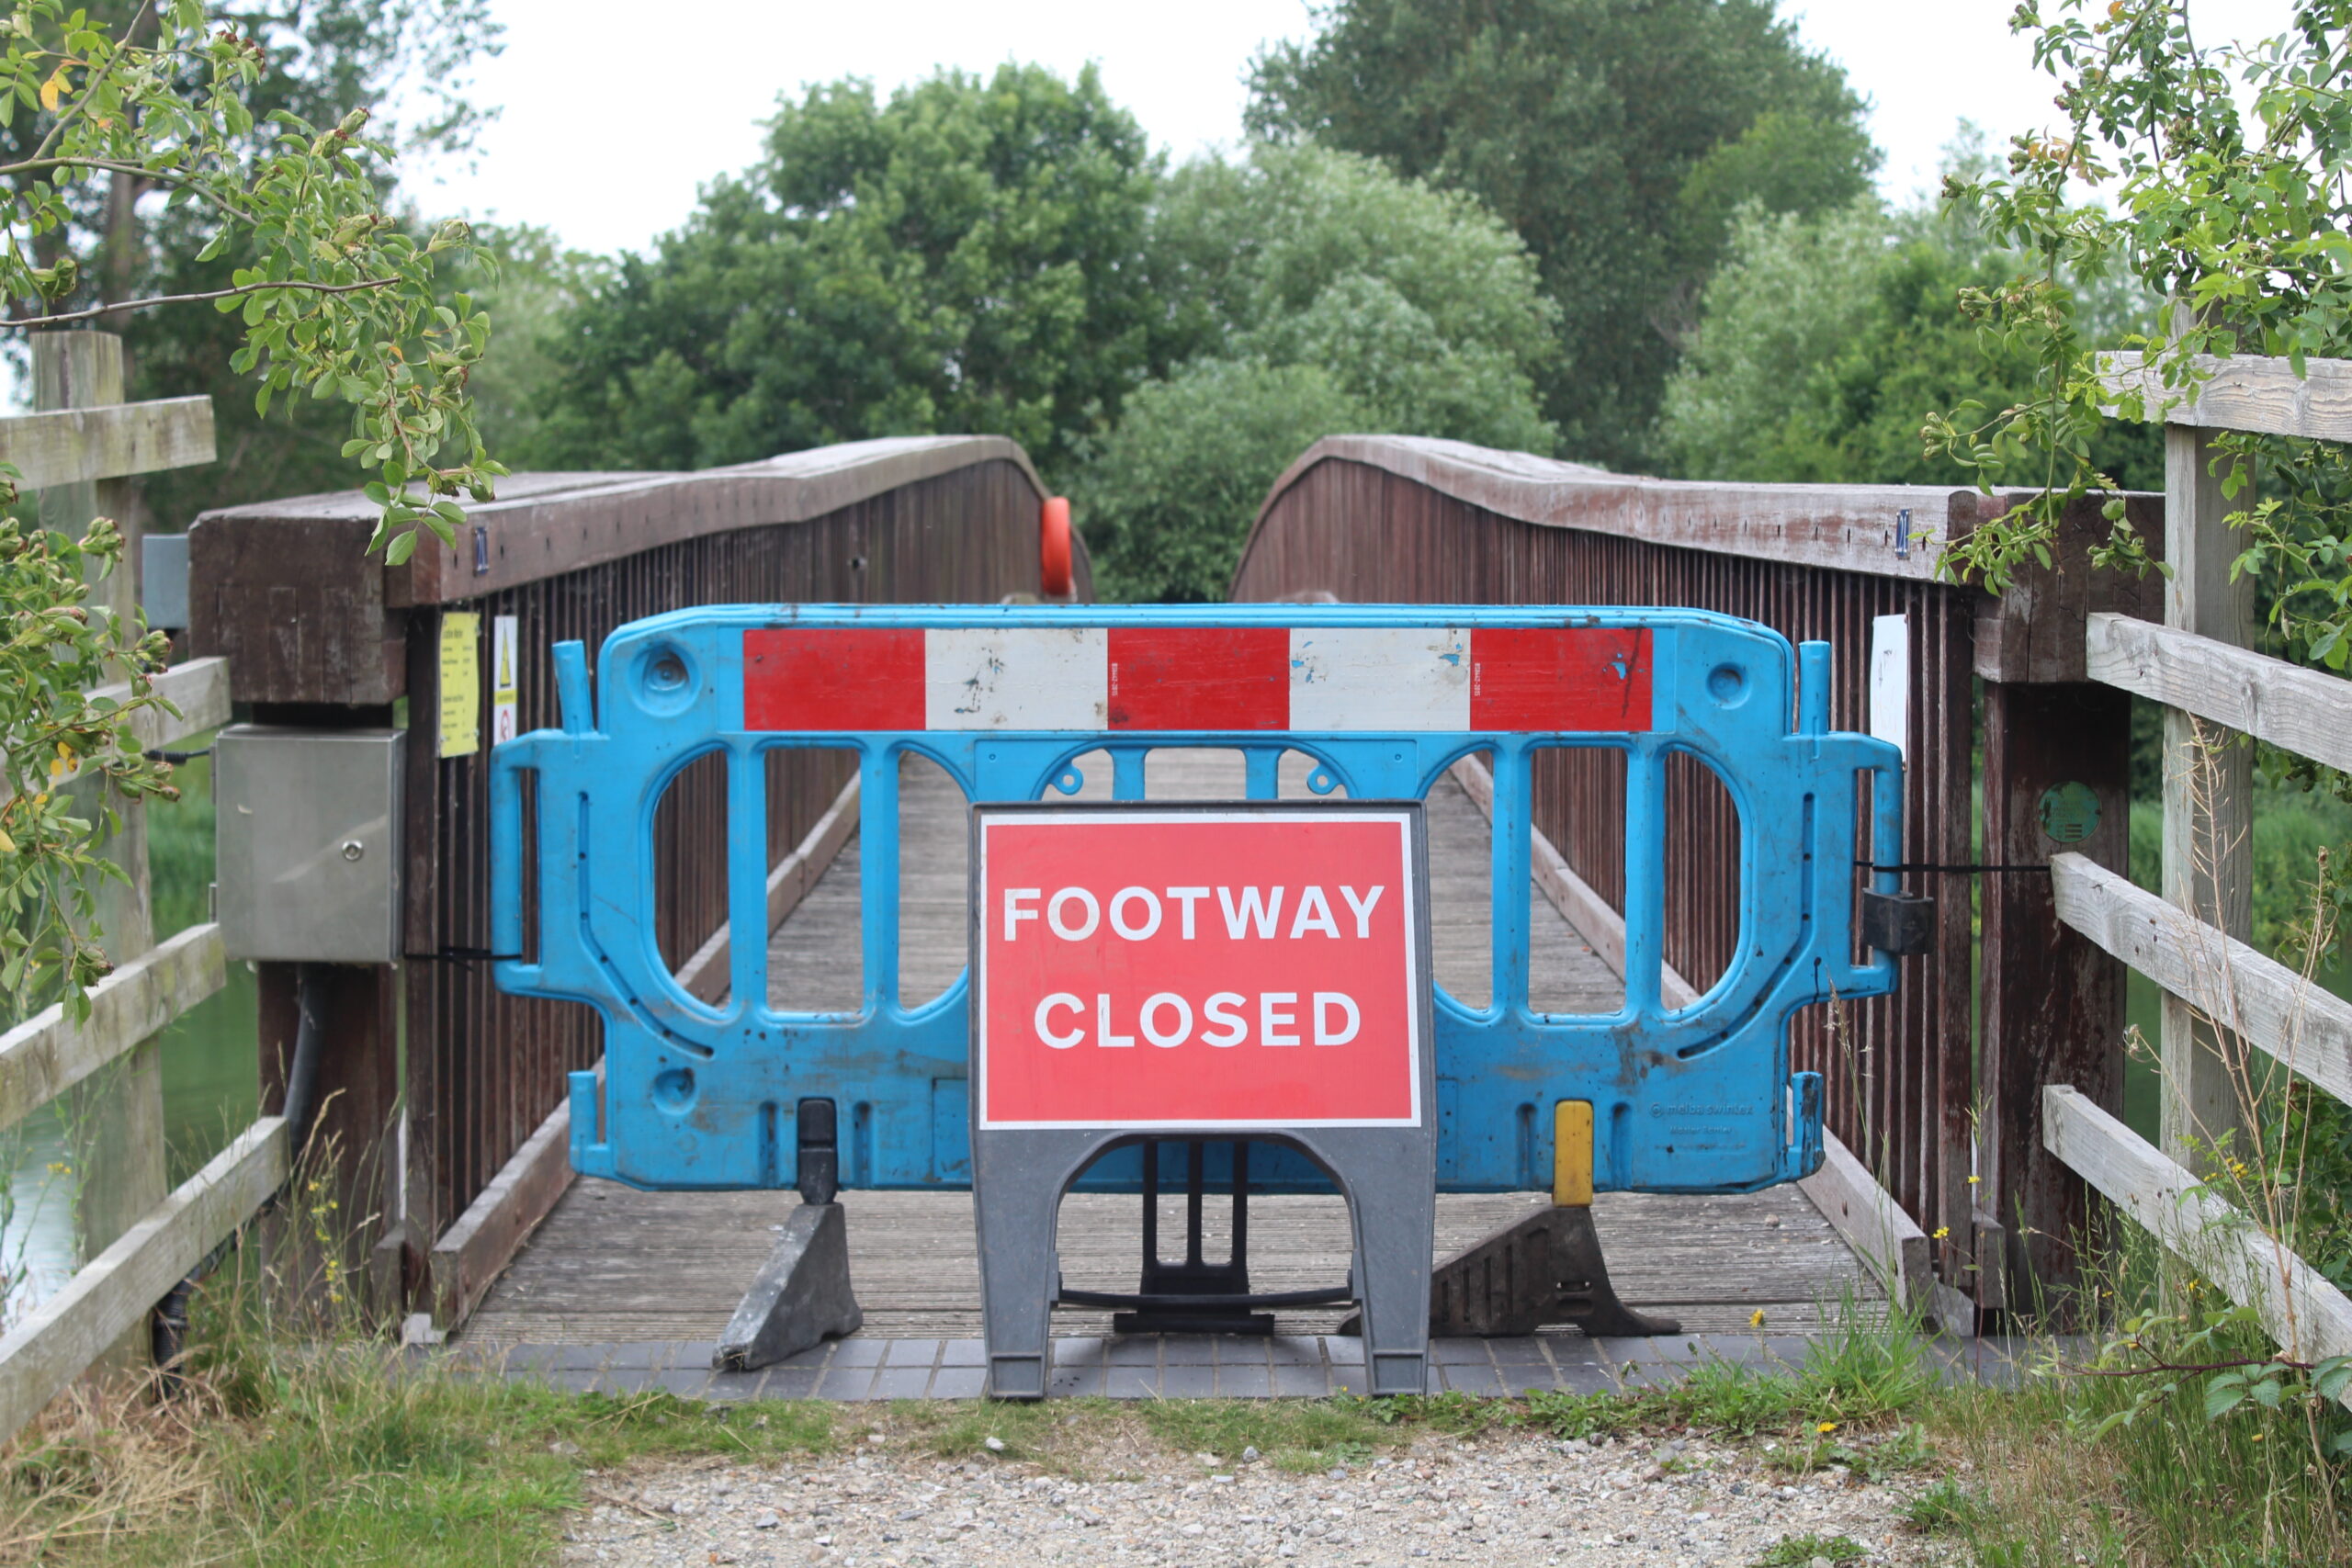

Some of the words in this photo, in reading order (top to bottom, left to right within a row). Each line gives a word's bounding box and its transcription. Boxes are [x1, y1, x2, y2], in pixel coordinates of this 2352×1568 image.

[1004, 885, 1385, 942] FOOTWAY
[1035, 991, 1361, 1049] CLOSED
[1668, 1102, 1703, 1115] melba
